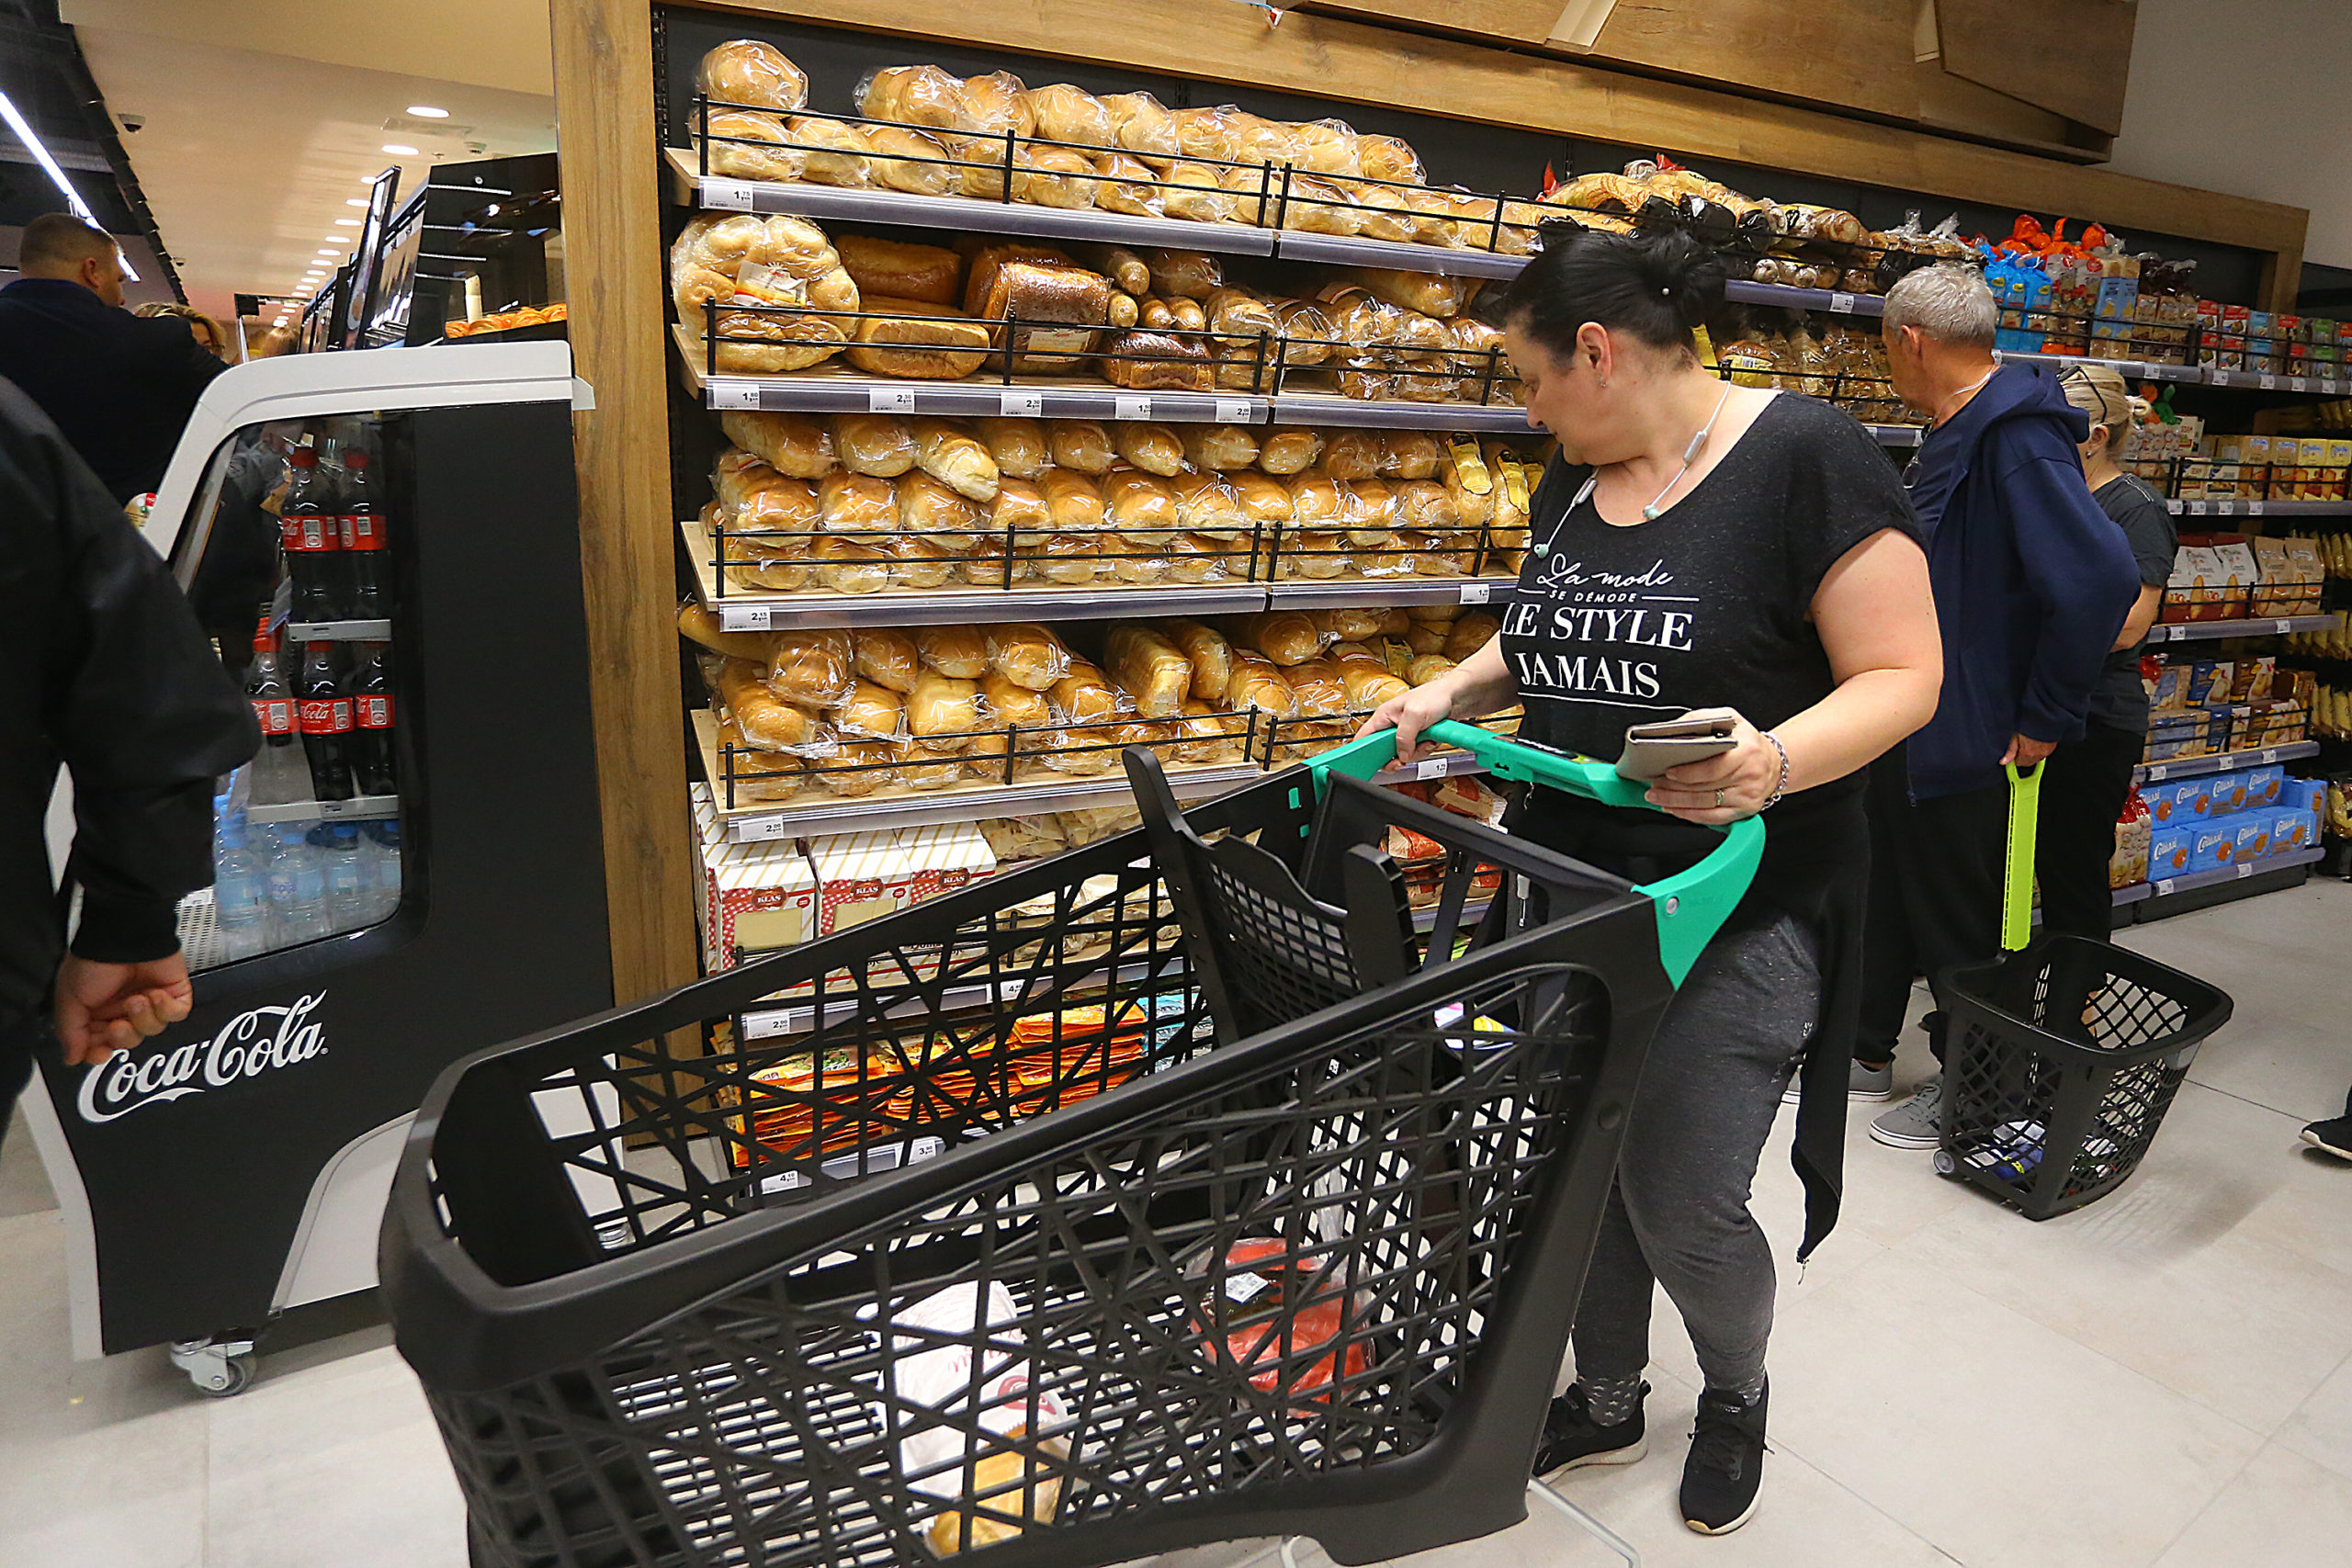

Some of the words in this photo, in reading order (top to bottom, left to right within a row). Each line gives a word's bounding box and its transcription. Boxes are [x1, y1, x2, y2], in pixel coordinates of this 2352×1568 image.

[1536, 552, 1589, 589] La
[1590, 558, 1674, 588] mode
[1549, 590, 1567, 601] SE
[1574, 590, 1638, 604] DÉMODE
[1501, 603, 1542, 637] LE
[1550, 606, 1693, 652] STYLE
[1515, 652, 1661, 698] JAMAIS
[855, 885, 879, 895] KLAS
[944, 874, 966, 885] KLAS
[757, 894, 782, 904] KLAS
[77, 989, 327, 1123] Coca-Cola
